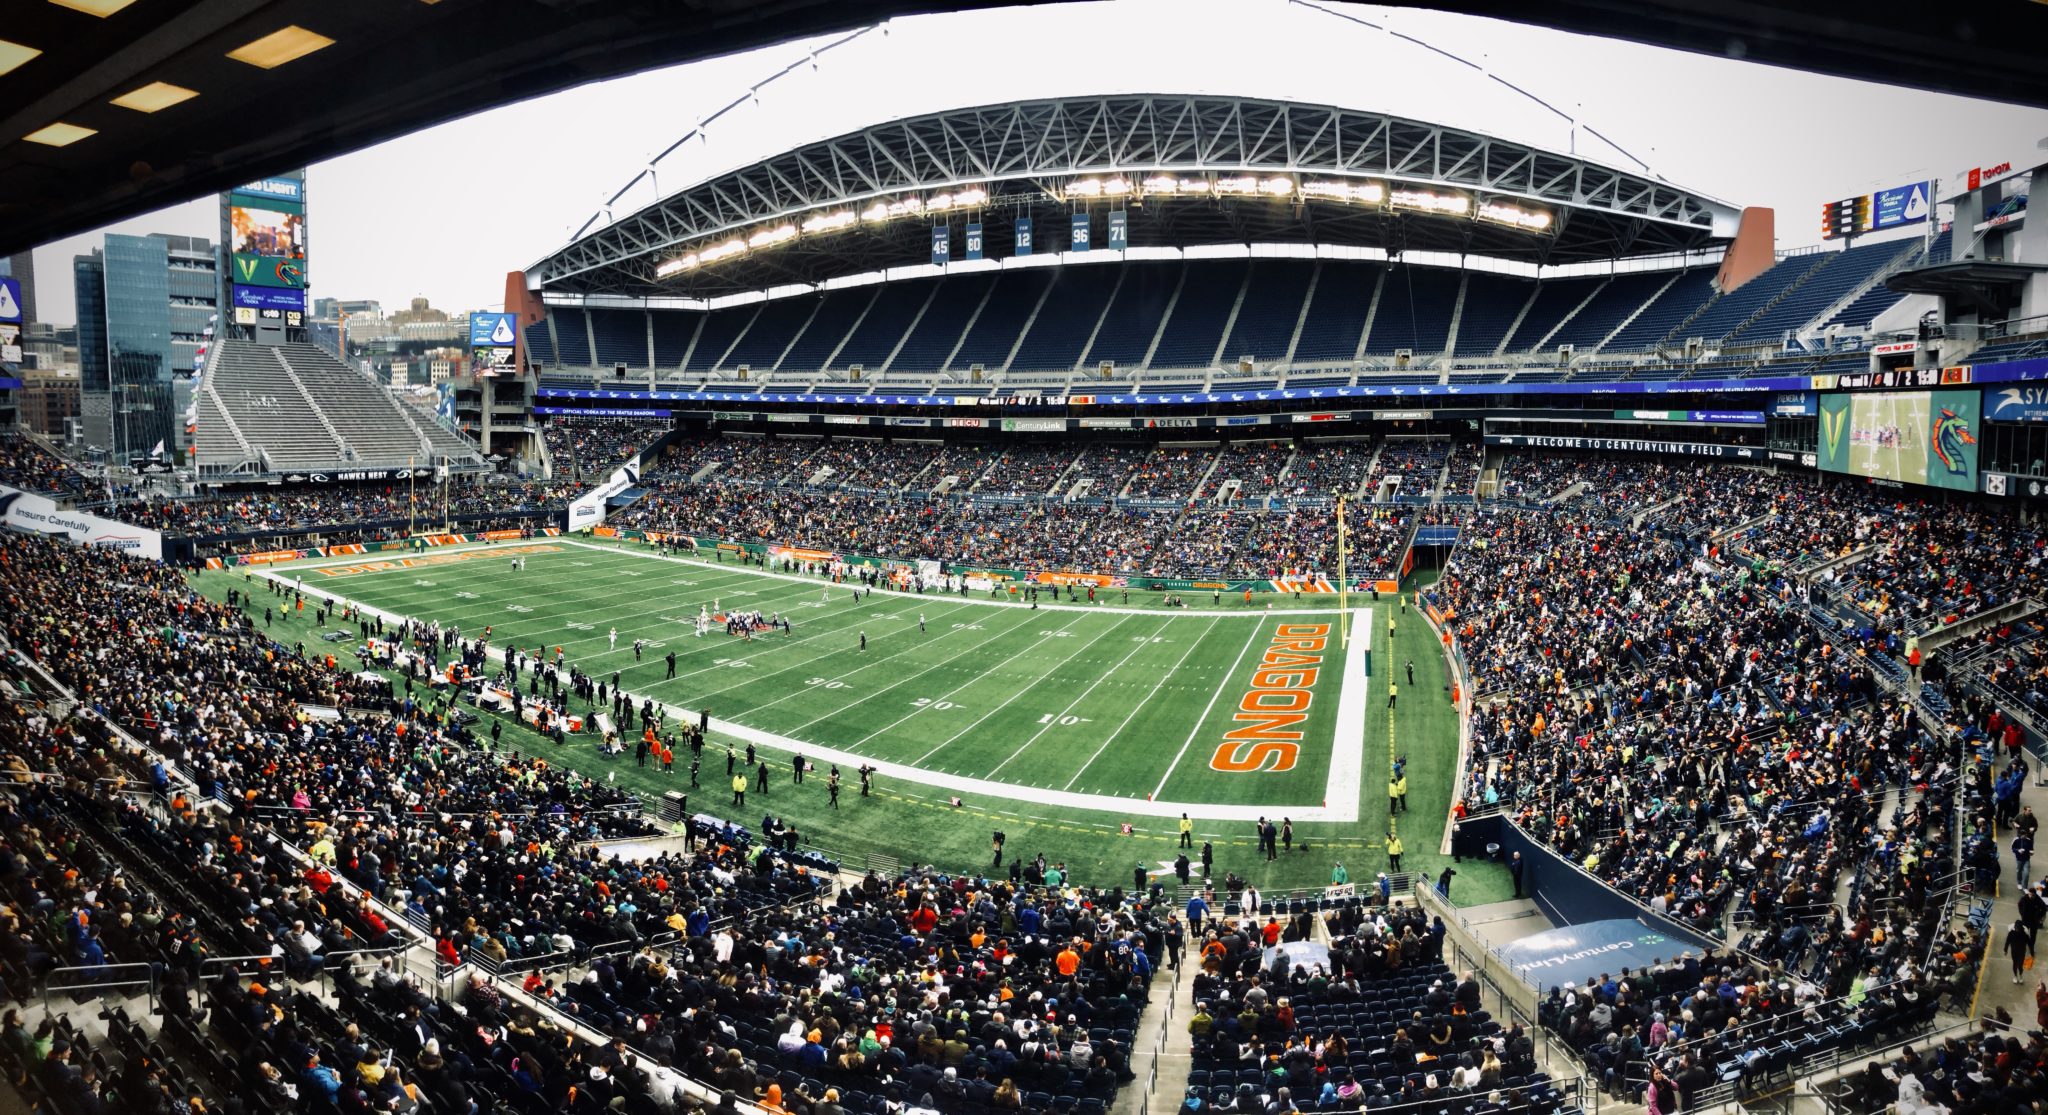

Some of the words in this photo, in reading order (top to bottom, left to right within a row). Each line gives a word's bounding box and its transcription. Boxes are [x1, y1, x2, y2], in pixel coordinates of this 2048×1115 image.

[1982, 161, 2011, 180] TOYOTA
[264, 182, 297, 195] LIGHT
[1017, 233, 1030, 247] 12
[1073, 229, 1088, 243] 96
[1111, 226, 1125, 241] 71
[933, 240, 948, 254] 45
[968, 237, 981, 252] 80
[1905, 370, 1912, 386] 2
[1036, 397, 1041, 405] 2
[951, 419, 979, 427] BECU
[1016, 421, 1060, 430] CenturyLink
[1527, 437, 1581, 448] WELCOME
[1587, 439, 1601, 449] TO
[1606, 440, 1684, 454] CENTURYLINK
[1691, 445, 1723, 456] FIELD
[338, 472, 366, 480] HAWKS
[368, 471, 388, 479] NEST
[15, 507, 46, 522] Insure
[48, 515, 91, 534] Carefully
[909, 697, 953, 711] 20
[1209, 623, 1332, 772] DRAGONS
[1036, 713, 1079, 726] 10
[1118, 945, 1129, 955] 80
[1516, 940, 1634, 971] CenturyLink
